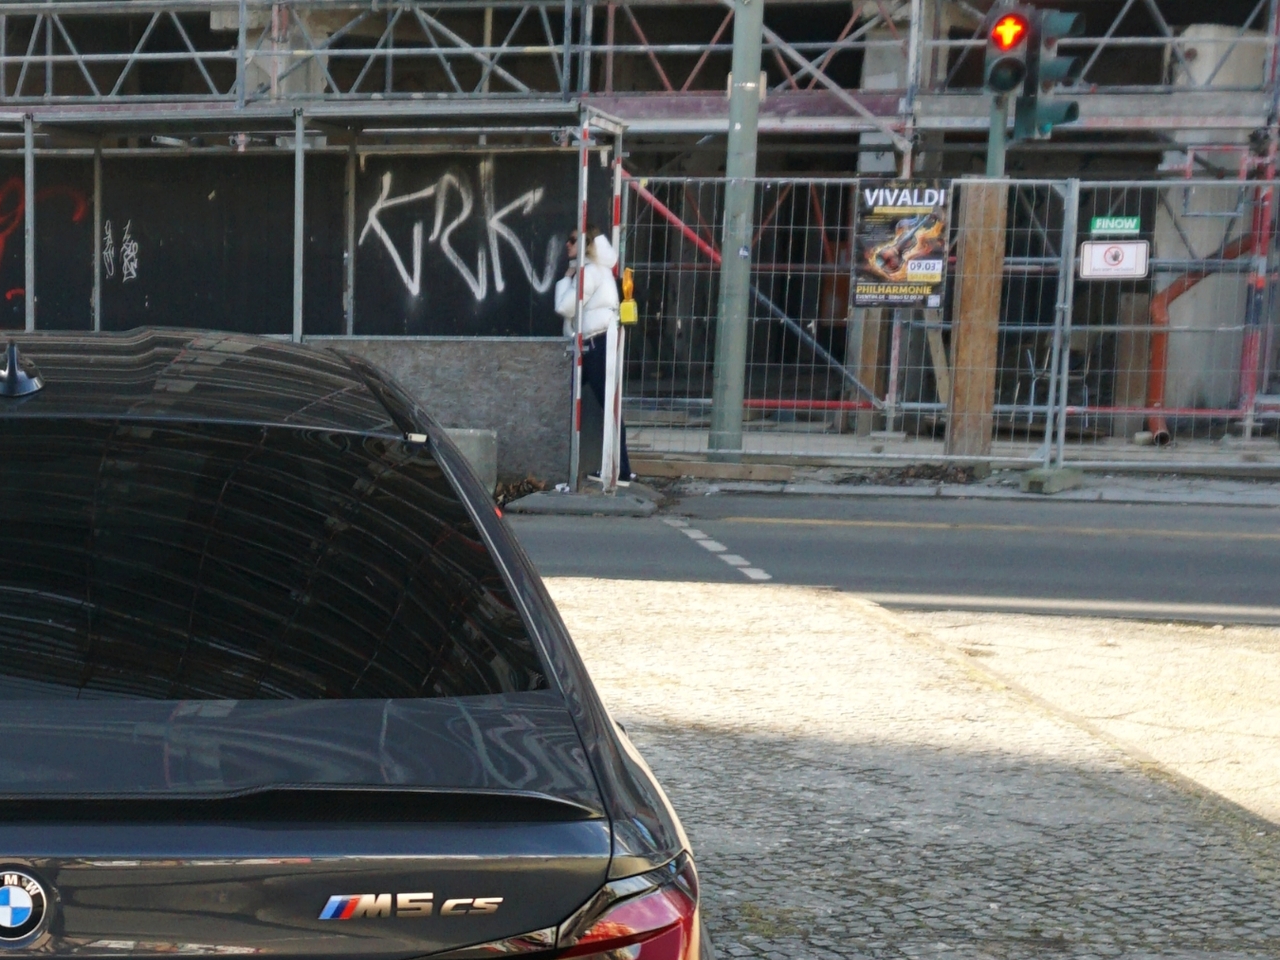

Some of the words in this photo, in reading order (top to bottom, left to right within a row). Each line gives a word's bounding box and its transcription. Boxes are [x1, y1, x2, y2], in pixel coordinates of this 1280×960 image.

[864, 187, 945, 207] VIVALDI
[1095, 217, 1138, 229] FINOW
[856, 285, 933, 295] PHILHARMONIE
[352, 892, 434, 918] M5
[440, 897, 504, 916] CS
